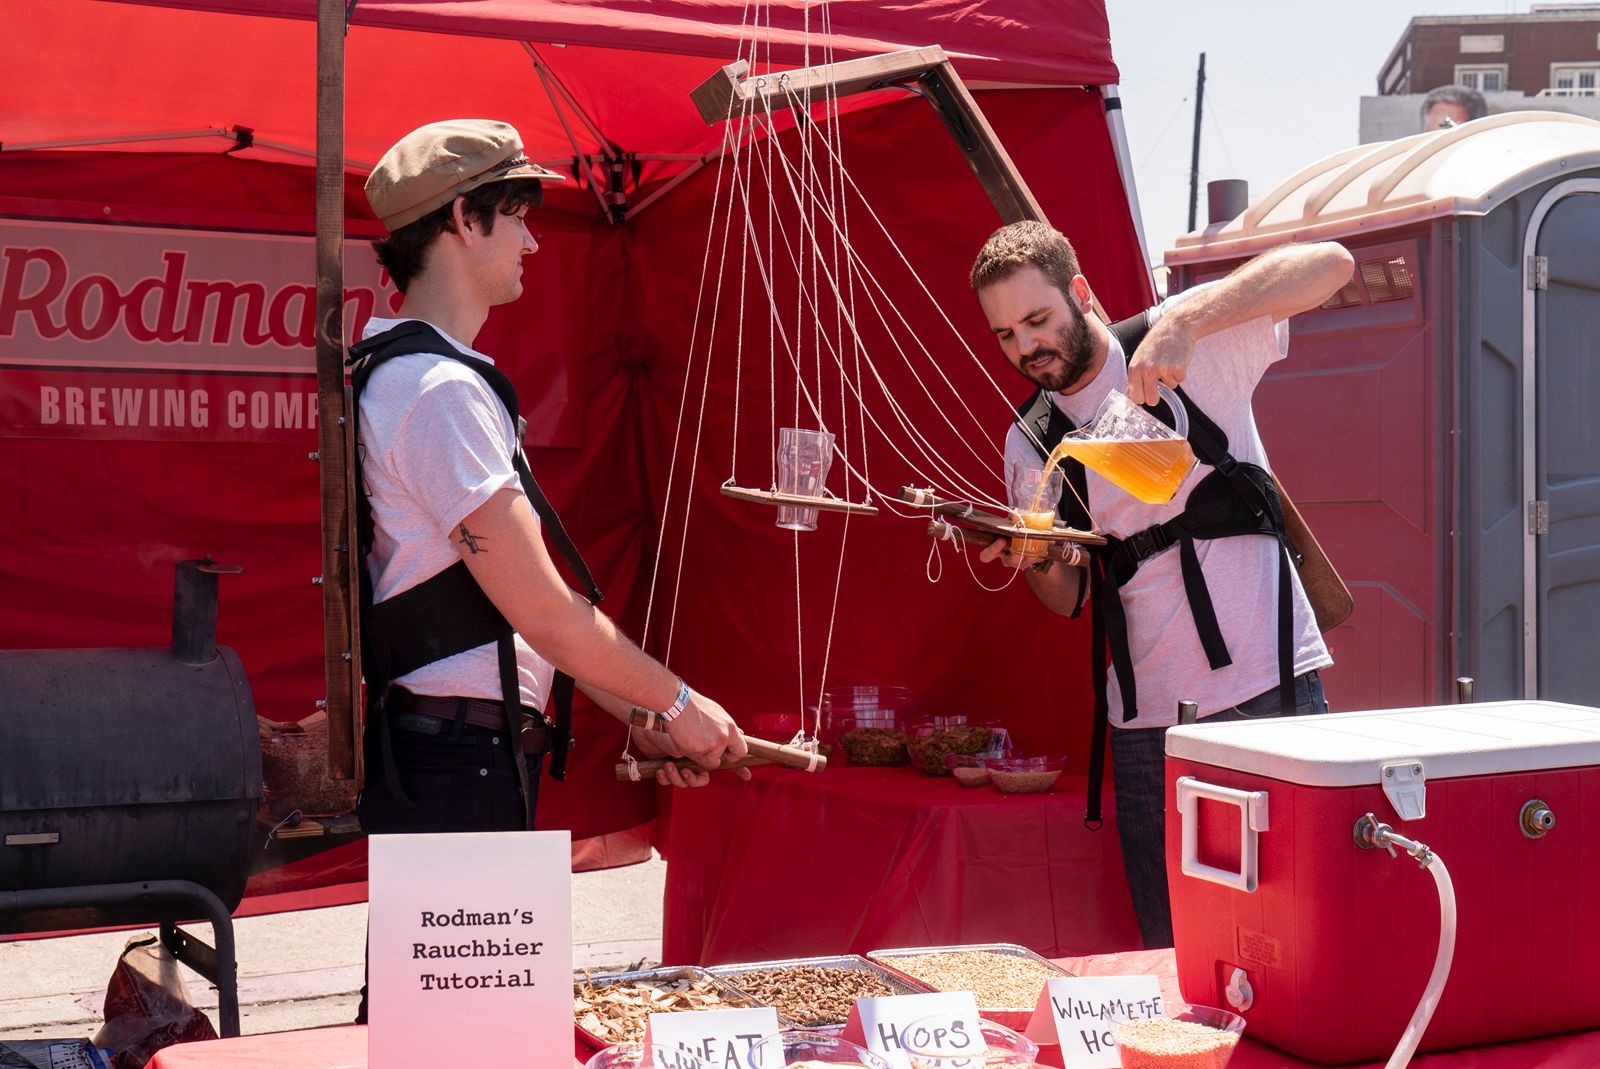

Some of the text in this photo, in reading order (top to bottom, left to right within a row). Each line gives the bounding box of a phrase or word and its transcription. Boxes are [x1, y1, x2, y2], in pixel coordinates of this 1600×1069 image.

[40, 386, 209, 428] BREWING
[421, 908, 534, 928] Rodman's
[412, 939, 544, 959] Rauchbier
[420, 969, 536, 991] Tutorial
[1052, 996, 1162, 1020] WILLAMETTE
[877, 1020, 971, 1052] HOPS
